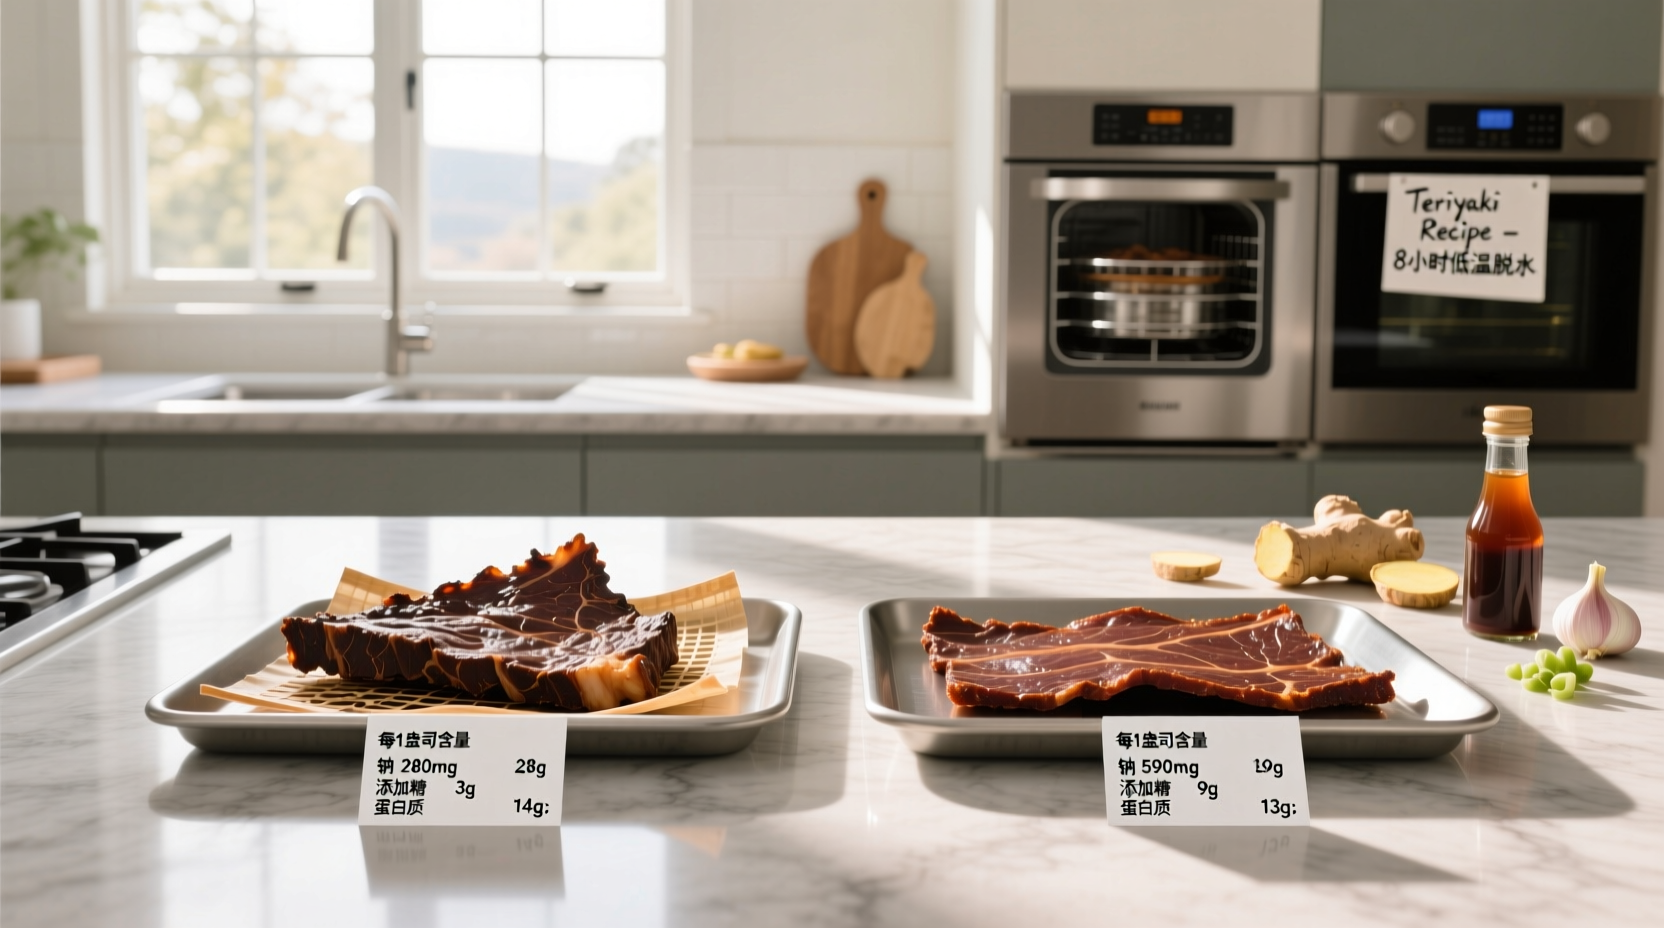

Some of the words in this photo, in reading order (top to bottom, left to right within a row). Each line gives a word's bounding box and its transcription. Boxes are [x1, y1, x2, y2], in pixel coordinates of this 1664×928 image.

[1405, 187, 1500, 221] Teriyaki
[1420, 218, 1491, 250] Recipe
[1393, 249, 1536, 277] 8小时低温脱水
[401, 758, 458, 778] 280mg
[515, 758, 546, 778] 28g
[1141, 759, 1199, 778] 590mg
[376, 778, 427, 796] 添加糖
[455, 780, 476, 799] 3g
[1120, 778, 1171, 797] 添加糖
[1197, 780, 1218, 800] 9g
[374, 799, 424, 815] 蛋白质
[1120, 799, 1171, 816] 蛋白质
